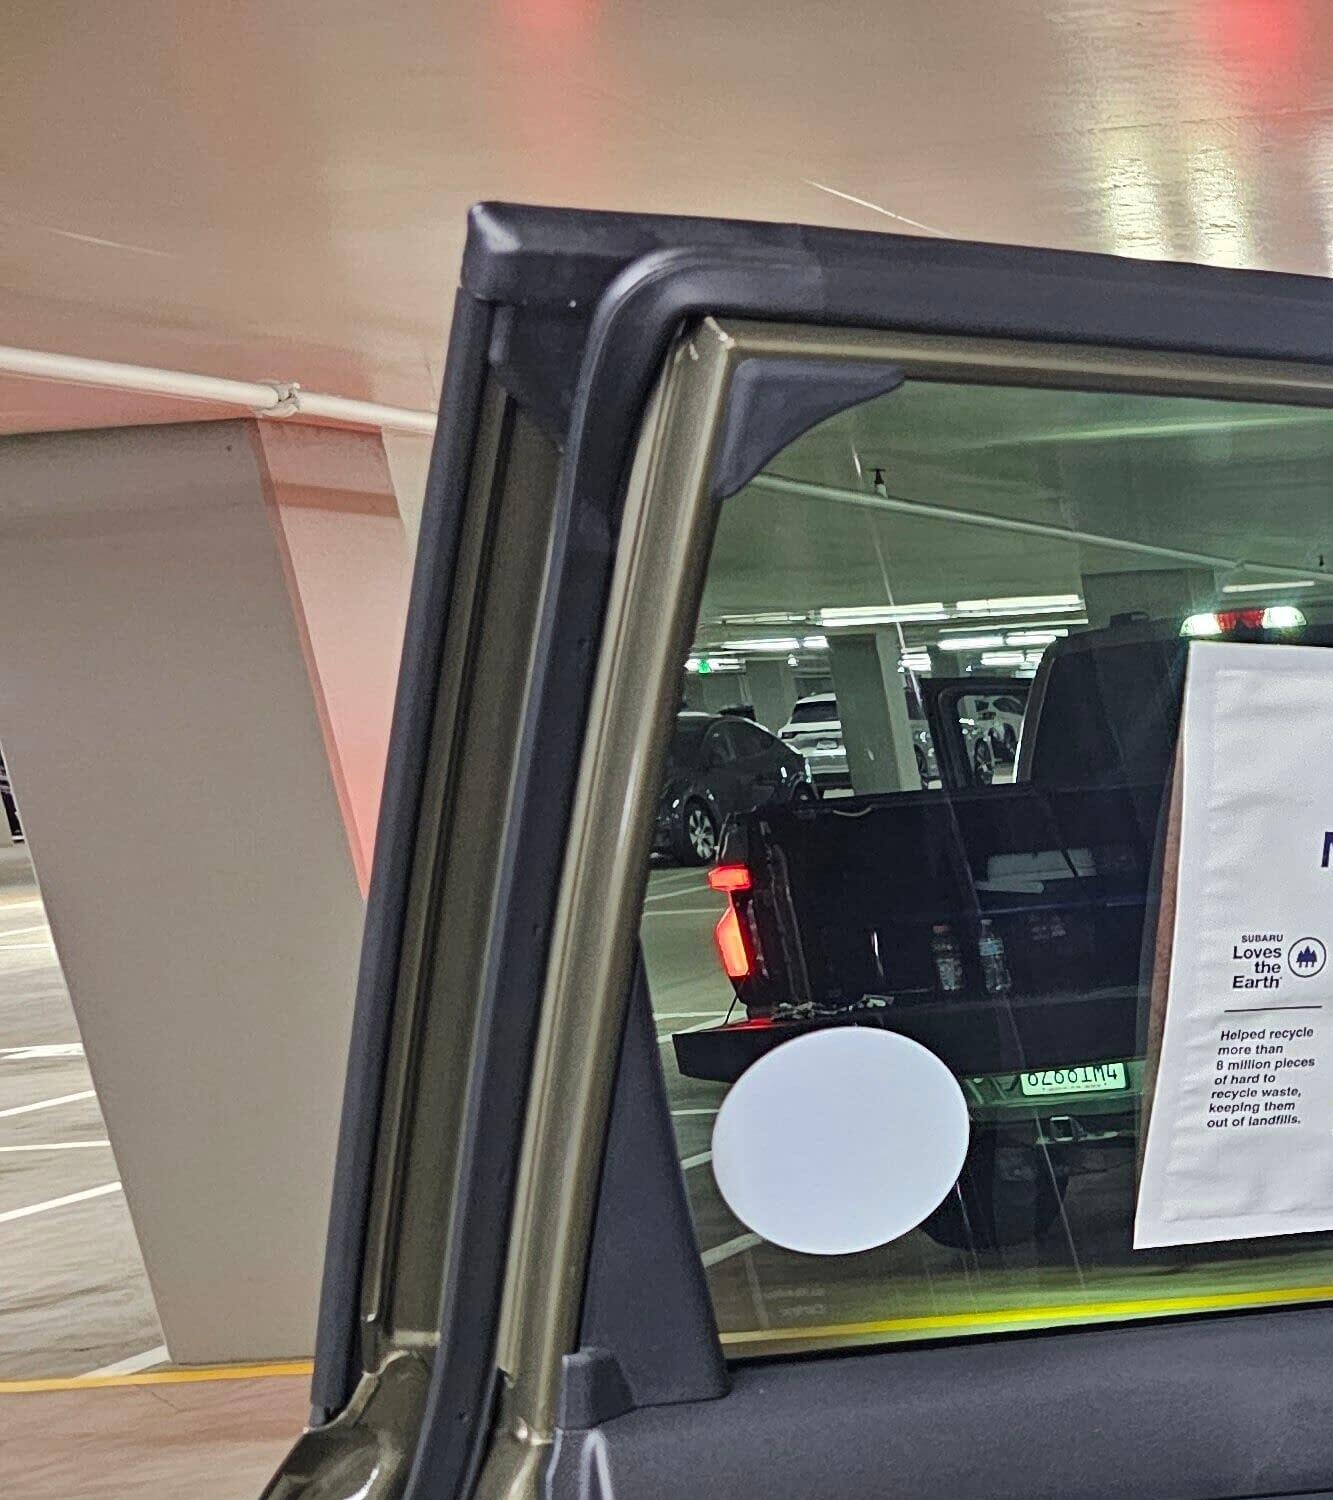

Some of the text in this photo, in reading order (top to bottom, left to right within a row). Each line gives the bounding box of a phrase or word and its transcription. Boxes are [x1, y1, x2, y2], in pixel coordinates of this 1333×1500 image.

[1241, 934, 1284, 944] SUBARU
[1232, 945, 1282, 960] Loves
[1254, 961, 1281, 974] the
[1232, 975, 1281, 989] Earth
[1220, 1026, 1314, 1042] Helped recycle
[1217, 1044, 1284, 1056] more than
[1227, 1059, 1271, 1071] million
[1274, 1057, 1315, 1071] pieces
[1214, 1073, 1276, 1086] of hard to
[1211, 1086, 1301, 1101] recycle waste,
[1208, 1101, 1295, 1114] keeping them
[1206, 1114, 1301, 1128] out of landfills.
